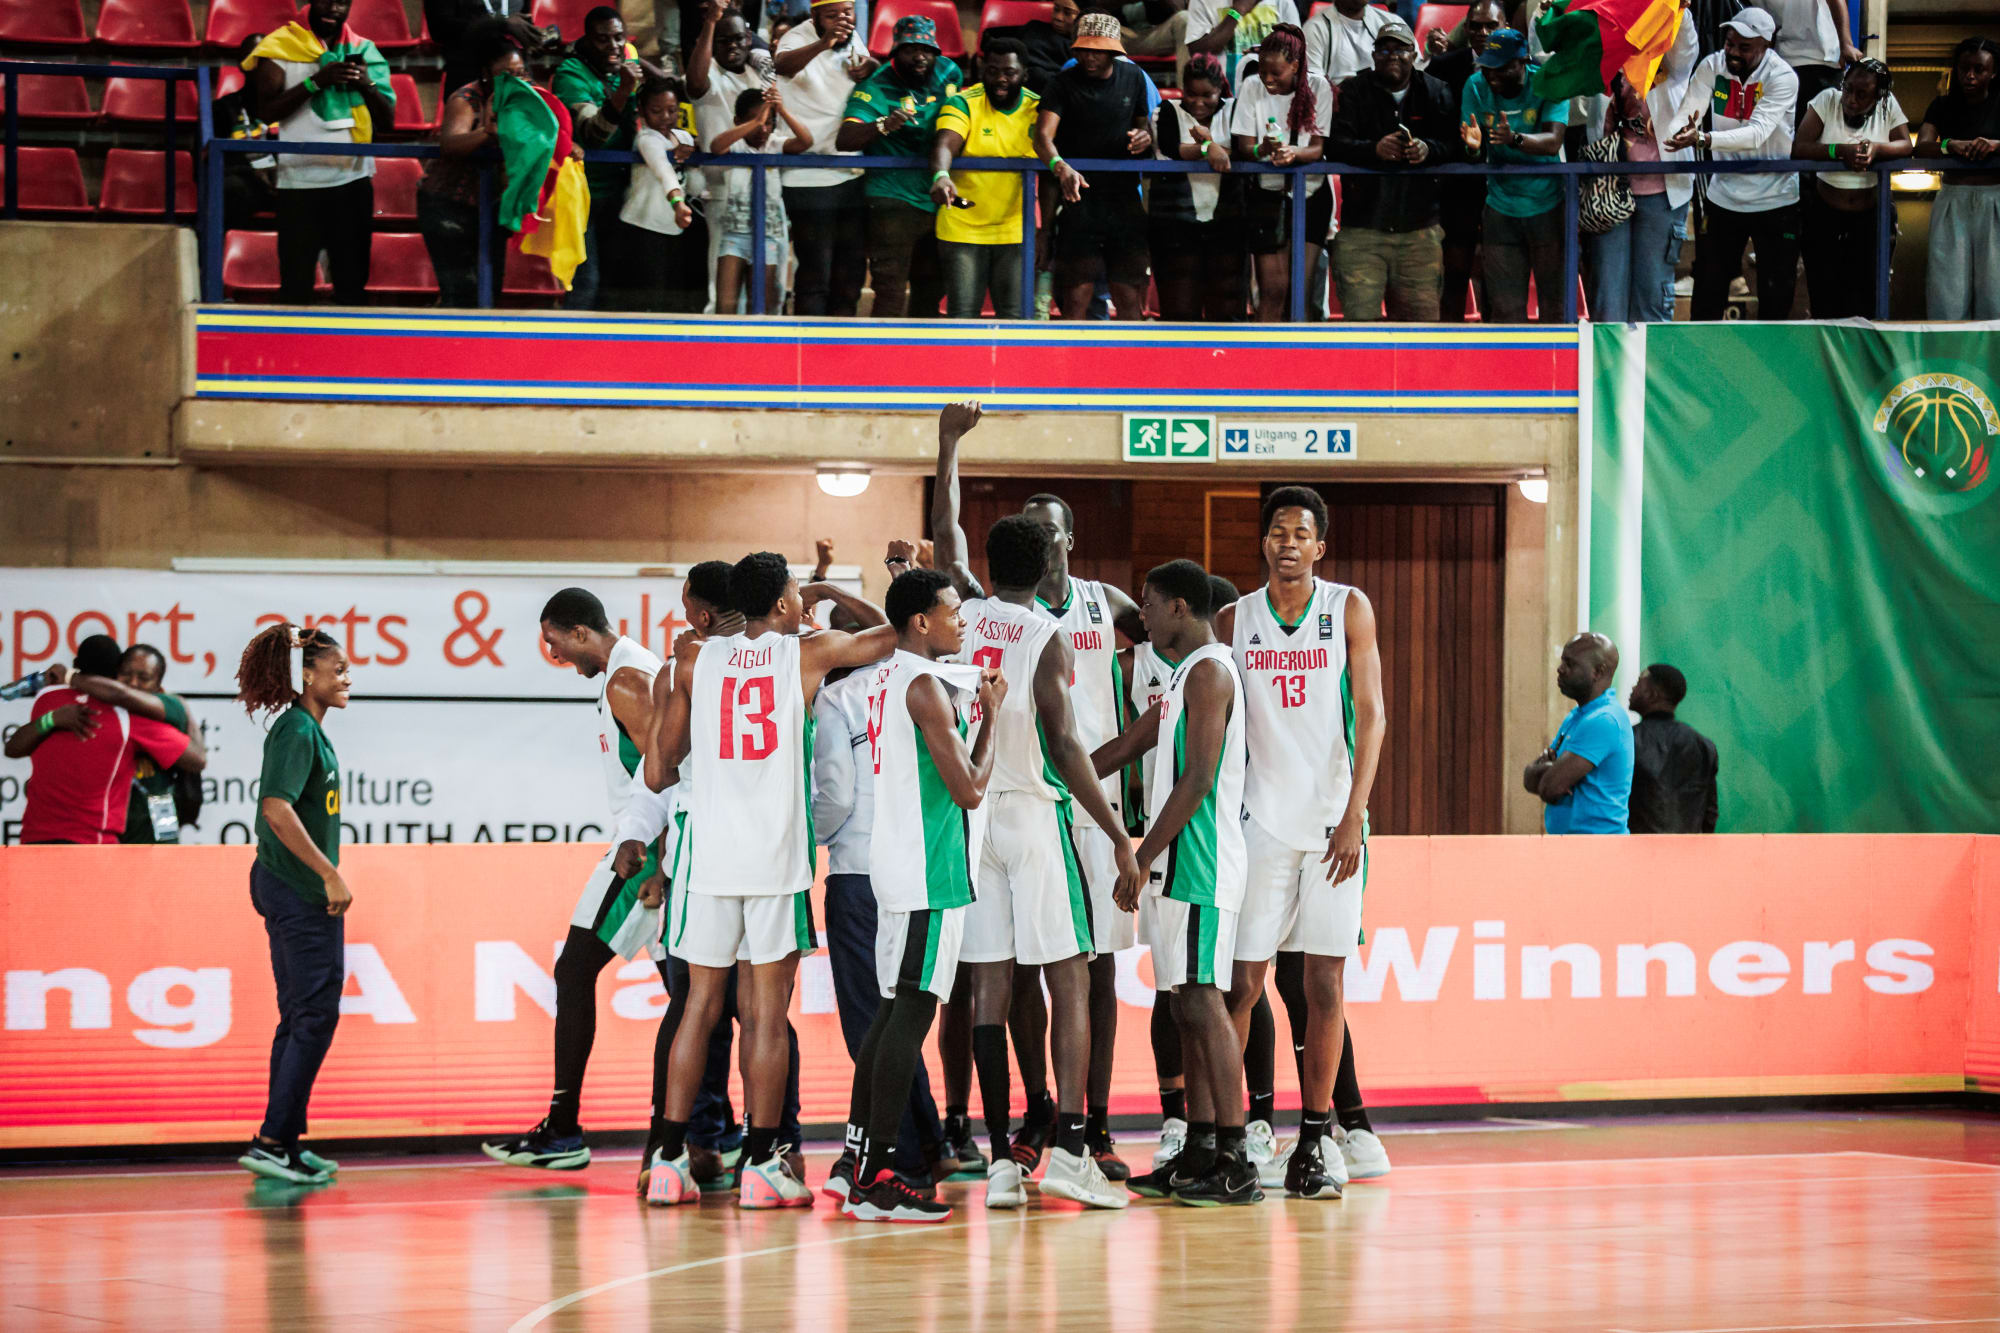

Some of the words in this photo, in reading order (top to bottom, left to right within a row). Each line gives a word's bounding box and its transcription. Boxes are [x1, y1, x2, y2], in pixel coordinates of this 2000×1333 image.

[1254, 428, 1297, 441] Uitgang
[1254, 443, 1275, 454] Exit
[1305, 429, 1318, 453] 2
[0, 602, 216, 681] port,
[255, 605, 408, 666] rts
[443, 590, 505, 668] &
[974, 611, 1023, 643] ASSINA
[728, 647, 771, 669] ZIGUI
[1245, 648, 1328, 671] CAMEROUN
[1272, 675, 1306, 708] 13
[719, 676, 778, 760] 13
[347, 770, 433, 806] lture
[4, 966, 231, 1048] ng
[1343, 920, 1935, 1002] Winners
